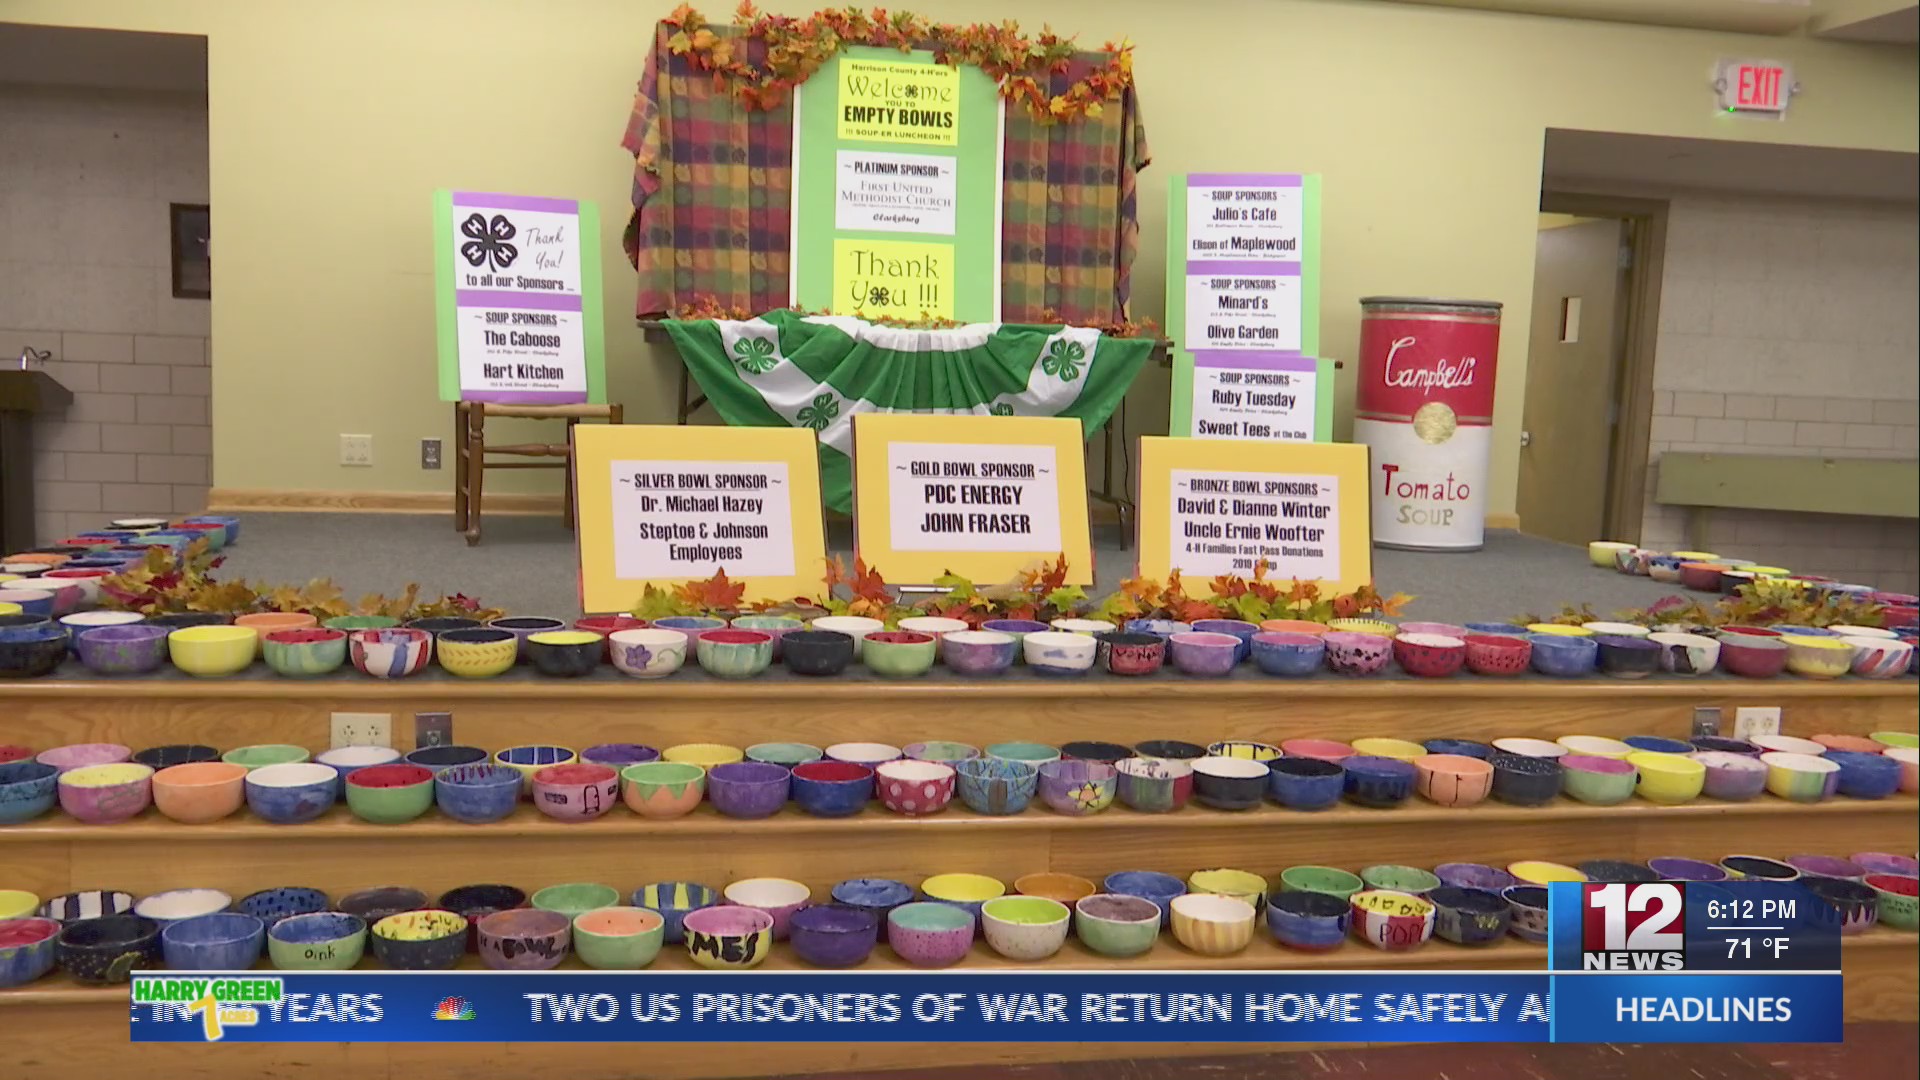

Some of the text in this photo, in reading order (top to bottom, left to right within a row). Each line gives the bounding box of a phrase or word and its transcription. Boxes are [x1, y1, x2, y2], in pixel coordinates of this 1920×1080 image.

[889, 65, 917, 77] County
[1737, 64, 1783, 106] EXIT
[885, 100, 902, 108] YOU
[844, 105, 953, 129] EMPTY BOWLS
[854, 160, 898, 175] PLATINUM
[900, 163, 939, 178] SPONSOR
[1212, 190, 1233, 201] SOUP
[1235, 191, 1278, 202] SPONSORS
[1212, 207, 1248, 221] Julio's
[525, 226, 564, 247] Thank
[1231, 236, 1296, 253] Maplewood
[850, 249, 940, 280] Thank
[466, 273, 478, 287] to
[480, 273, 493, 287] all
[496, 276, 514, 288] our
[517, 275, 564, 291] Sponsors
[1210, 278, 1232, 290] SOUP
[1234, 279, 1277, 290] SPONSORS
[919, 283, 939, 308] !!!
[1218, 295, 1269, 310] Minard's
[485, 311, 509, 324] SOUP
[512, 313, 557, 326] SPONSORS
[484, 330, 561, 348] The Caboose
[1207, 324, 1279, 340] Olive Garden
[483, 362, 564, 380] Hart Kitchen
[1384, 337, 1476, 395] Campbell's
[1219, 372, 1242, 384] SOUP
[1245, 373, 1290, 386] SPONSORS
[1212, 389, 1296, 409] Ruby Tuesday
[1199, 419, 1239, 436] Sweet
[1242, 421, 1271, 438] Tees
[911, 461, 940, 476] GOLD
[943, 462, 978, 477] BOWL
[981, 463, 1035, 478] SPONSOR
[634, 473, 674, 488] SILVER
[678, 474, 711, 489] BOWL
[715, 474, 768, 489] SPONSOR
[1190, 479, 1230, 493] BRONZE
[1232, 480, 1262, 494] BOWL
[1264, 482, 1318, 496] SPONSORS
[1382, 463, 1470, 501] Tomato
[924, 484, 1023, 505] PDC ENERGY
[641, 495, 763, 515] Dr. Michael Hazey
[1178, 497, 1331, 519] David & Dianne Winter
[640, 522, 769, 542] Steptoe & Johnson
[921, 513, 1031, 534] JOHN FRASER
[1184, 521, 1325, 542] Uncle Ernie Woofter
[669, 543, 742, 563] Employees
[1203, 543, 1236, 554] Families
[1238, 544, 1257, 555] Fast
[1259, 545, 1280, 556] Pass
[1282, 546, 1324, 557] Donations
[1232, 558, 1252, 569] 2019
